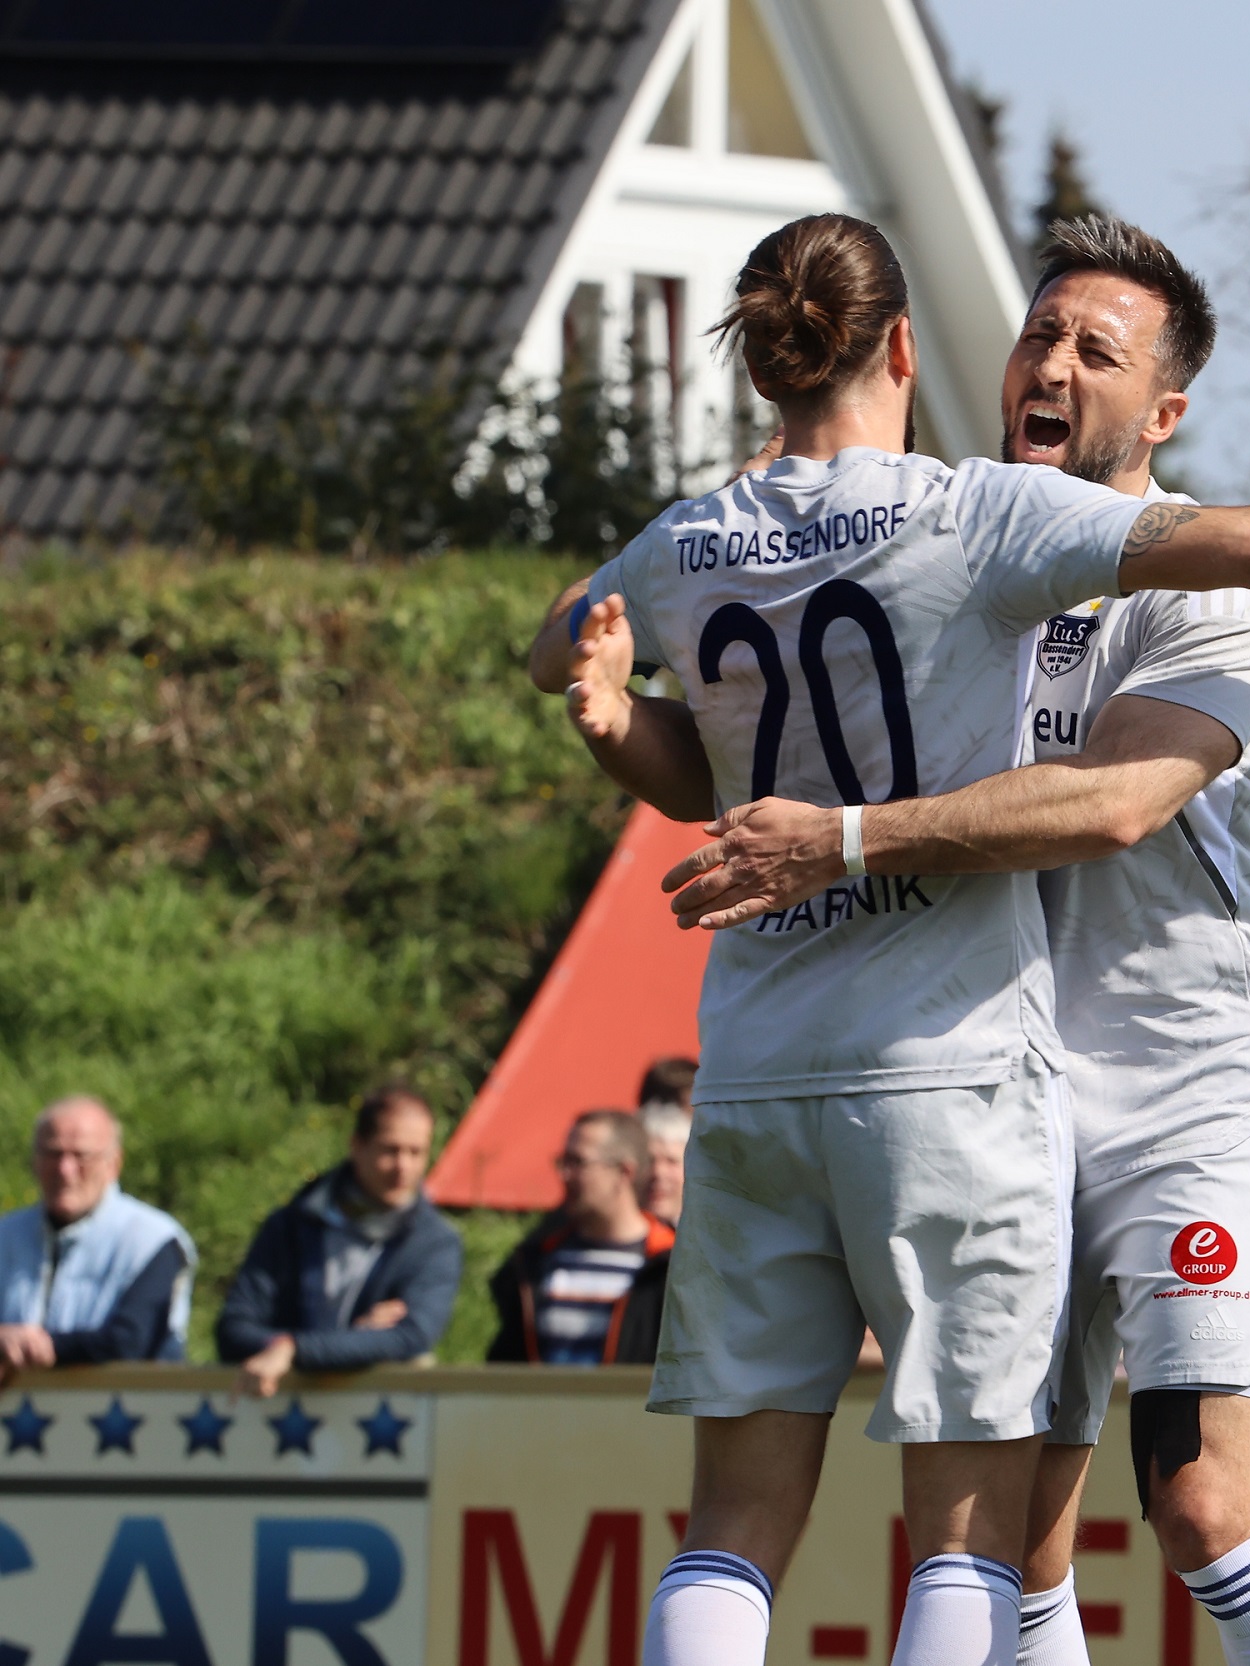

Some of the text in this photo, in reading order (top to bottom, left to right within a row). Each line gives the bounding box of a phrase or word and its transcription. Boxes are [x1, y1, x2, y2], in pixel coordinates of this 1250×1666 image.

[676, 502, 908, 576] TUS DASSENDORF
[1052, 620, 1088, 643] TuS
[698, 578, 918, 807] 20
[756, 875, 934, 933] HARNIK
[1182, 1263, 1227, 1275] GROUP
[1190, 1326, 1245, 1341] adidas
